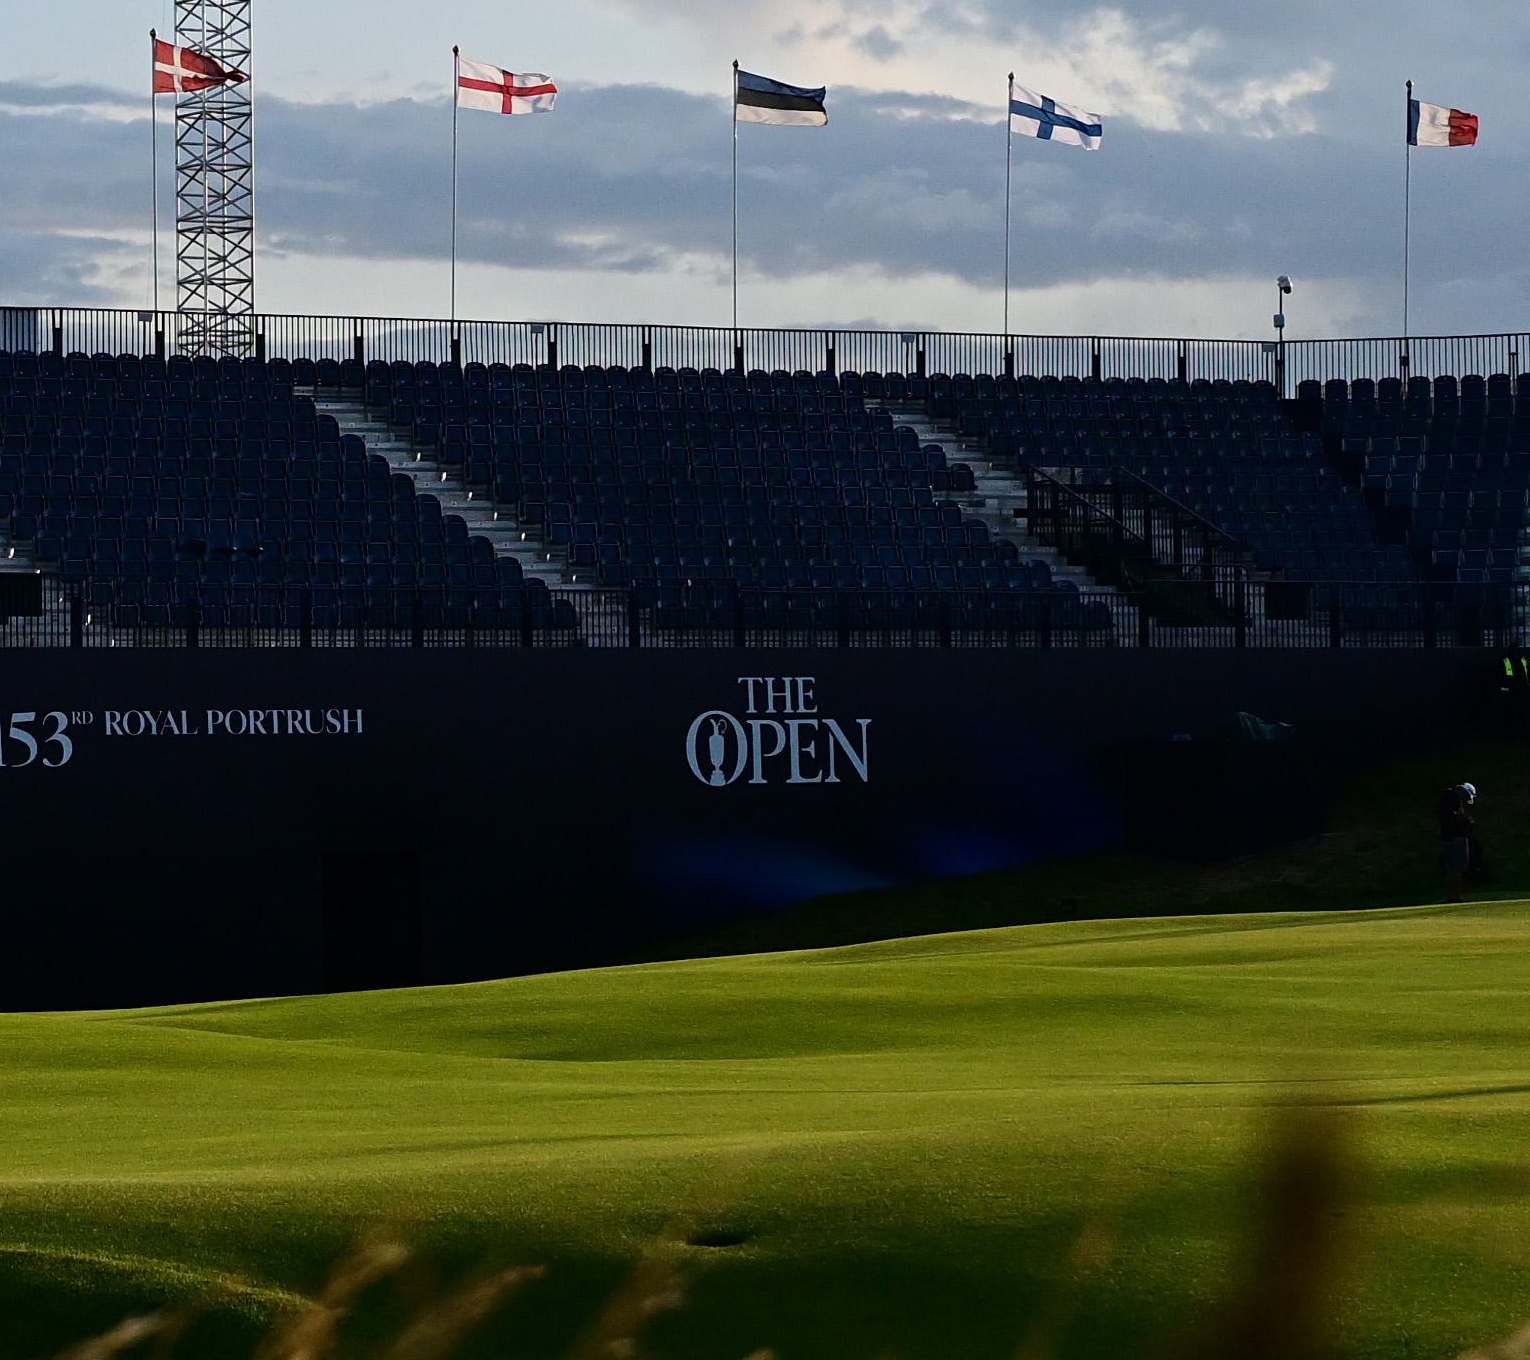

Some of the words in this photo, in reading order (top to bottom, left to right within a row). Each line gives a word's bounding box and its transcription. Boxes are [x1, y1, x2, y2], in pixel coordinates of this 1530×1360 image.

[738, 676, 818, 713] THE
[104, 709, 198, 736] ROYAL
[207, 708, 363, 735] PORTRUSH
[685, 710, 872, 787] OPEN
